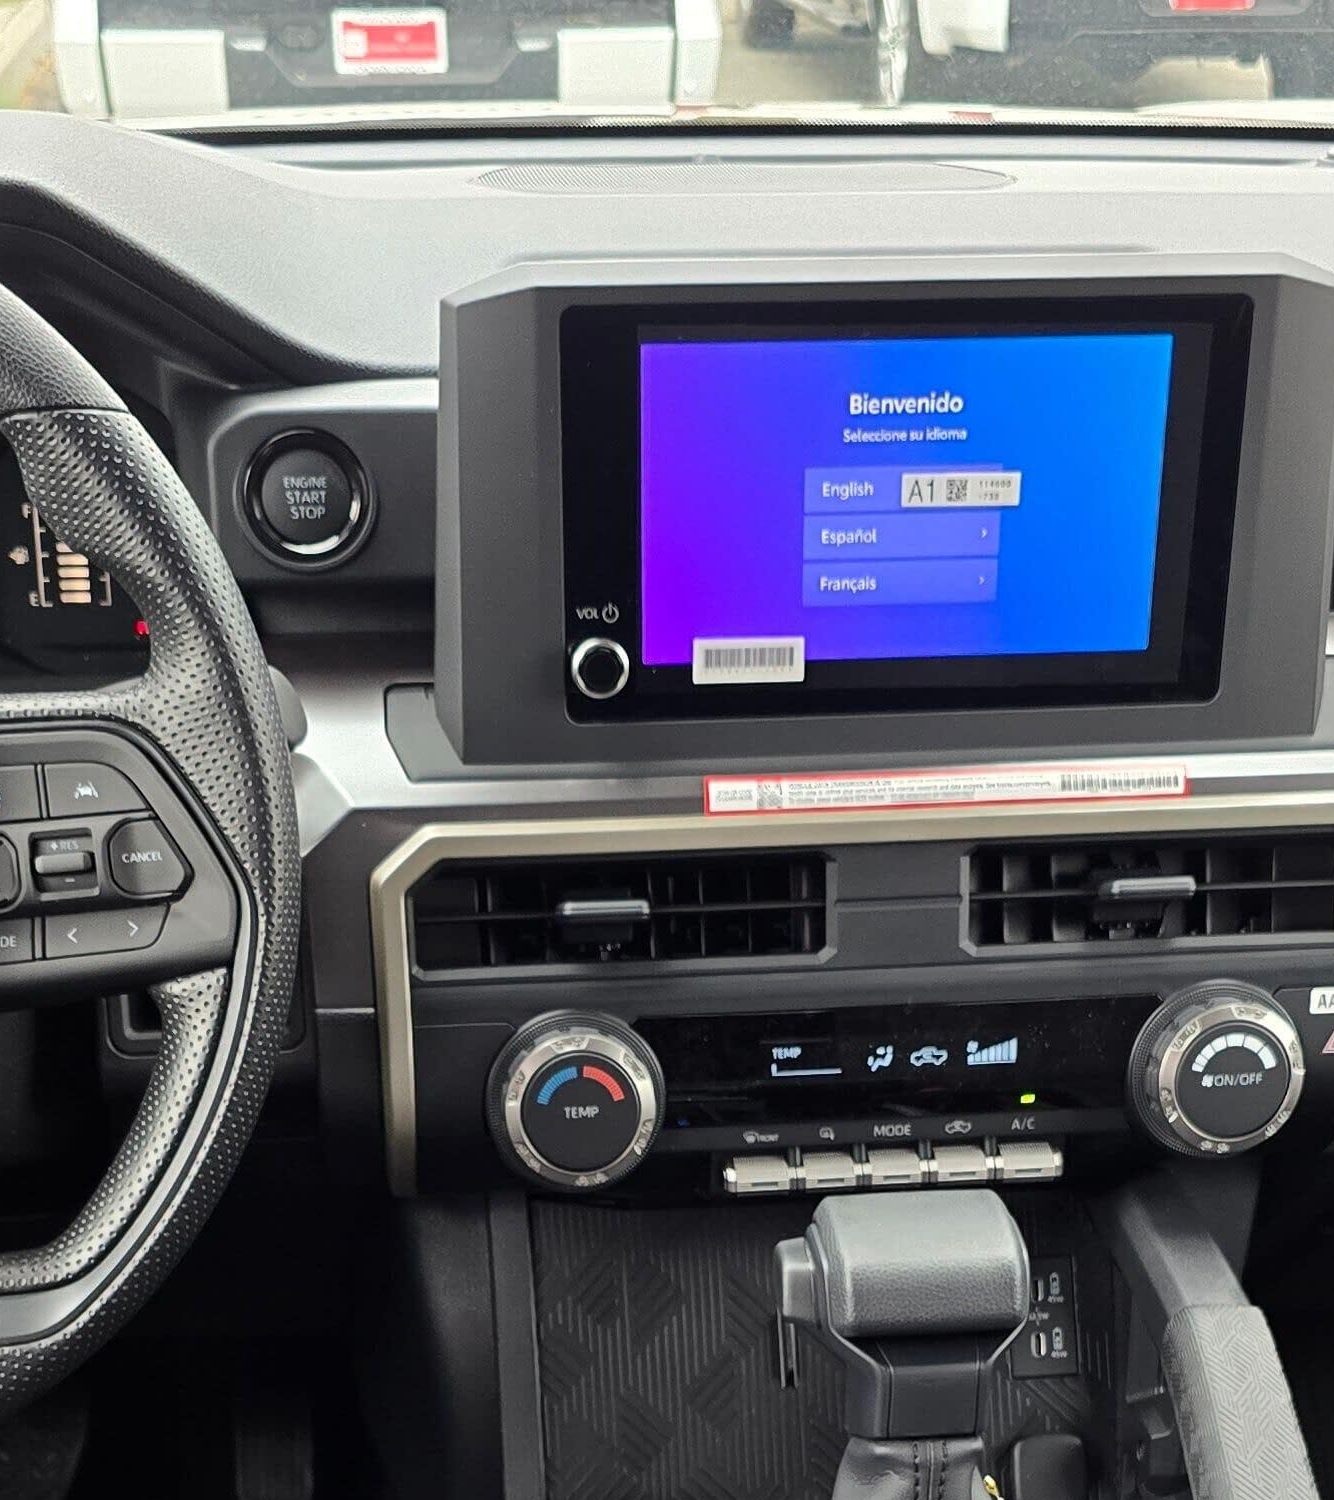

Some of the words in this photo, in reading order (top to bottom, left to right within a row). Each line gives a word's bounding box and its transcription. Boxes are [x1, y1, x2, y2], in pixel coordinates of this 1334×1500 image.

[849, 391, 964, 415] Bienvenido
[842, 428, 907, 443] Seleccione
[910, 431, 923, 441] su
[926, 427, 968, 442] idioma
[283, 476, 327, 488] ENGINE
[285, 490, 326, 504] START
[822, 481, 874, 500] English
[908, 479, 935, 503] A1
[290, 505, 325, 519] STOP
[821, 528, 877, 547] Español
[819, 576, 877, 594] Français
[576, 608, 599, 620] VOL
[122, 851, 163, 864] CANCEL
[772, 1047, 801, 1060] TEMP
[1214, 1072, 1263, 1087] ON/OFF
[563, 1105, 599, 1119] TEMP
[873, 1124, 912, 1137] MODE
[1011, 1117, 1035, 1131] A/C
